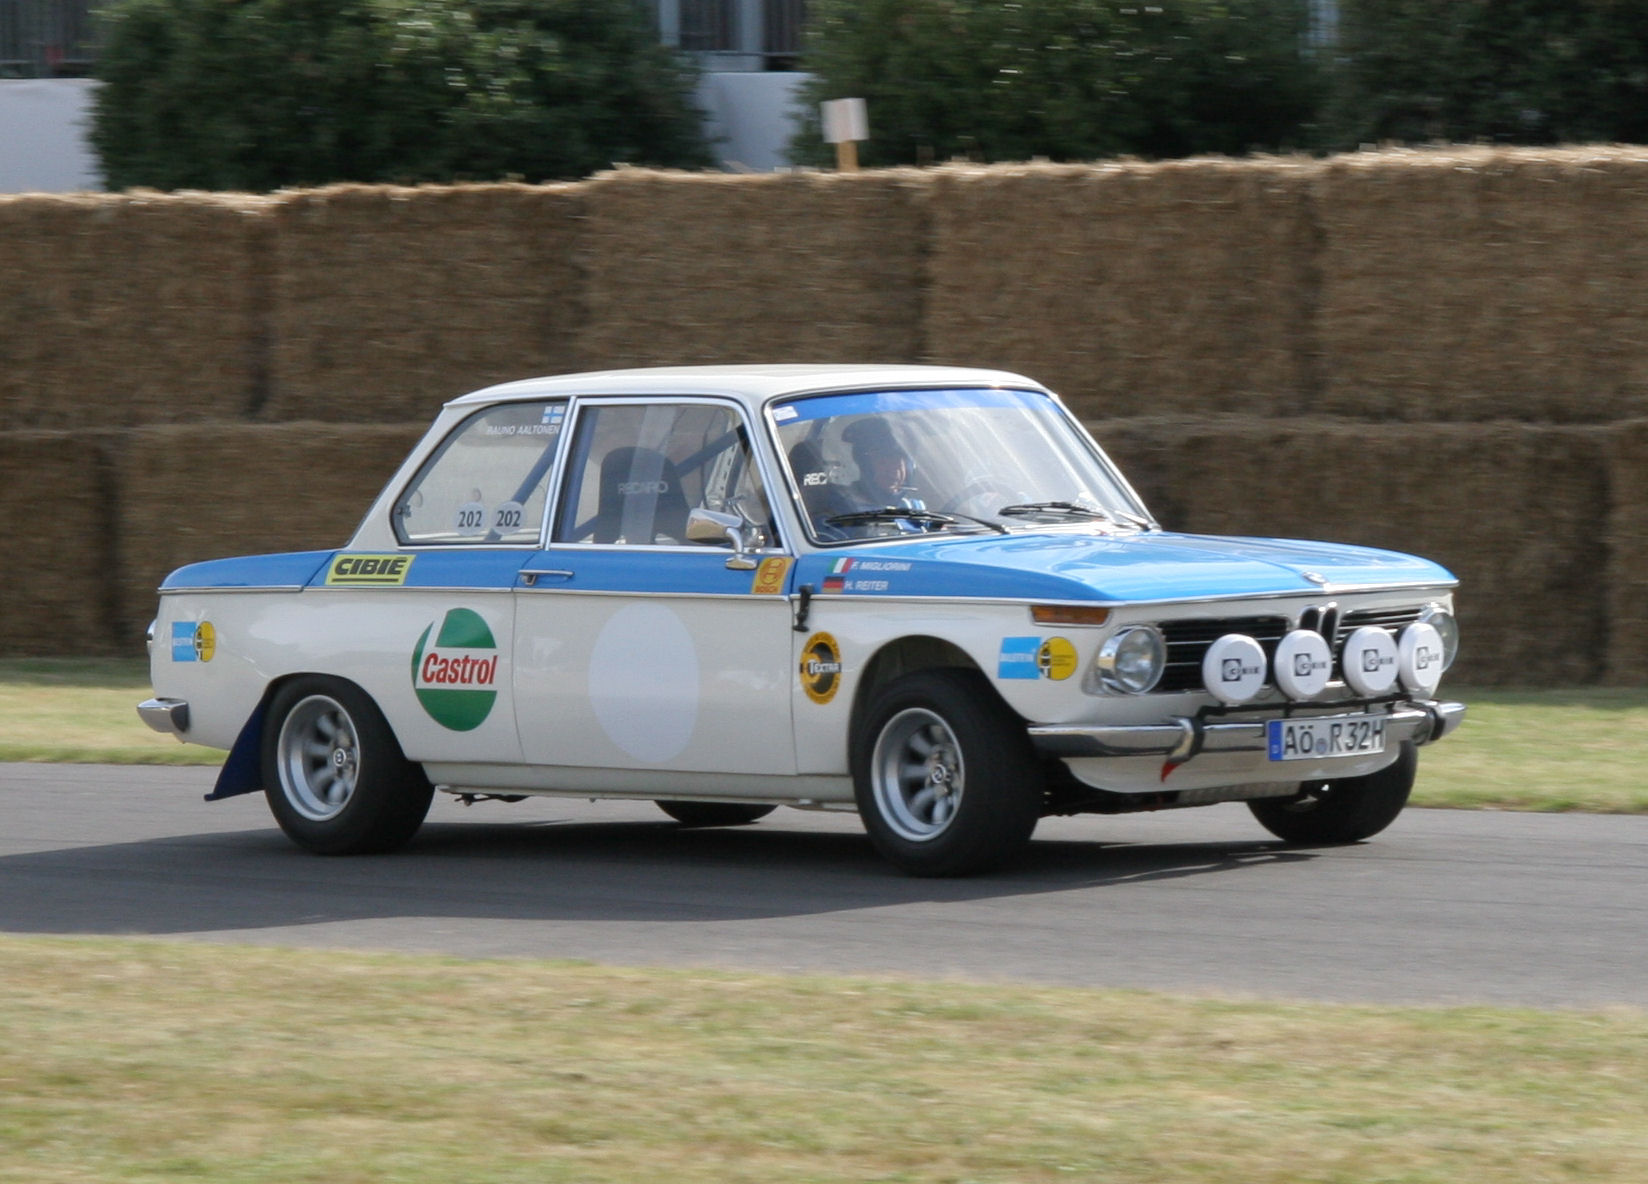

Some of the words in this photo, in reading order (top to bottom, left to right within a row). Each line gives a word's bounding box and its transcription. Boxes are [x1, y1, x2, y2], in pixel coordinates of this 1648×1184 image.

[517, 424, 560, 435] AALTONEN
[458, 510, 483, 527] 202
[496, 509, 521, 527] 202
[855, 581, 889, 591] REITER
[422, 652, 499, 685] Castrol
[1284, 722, 1313, 755] AÖ
